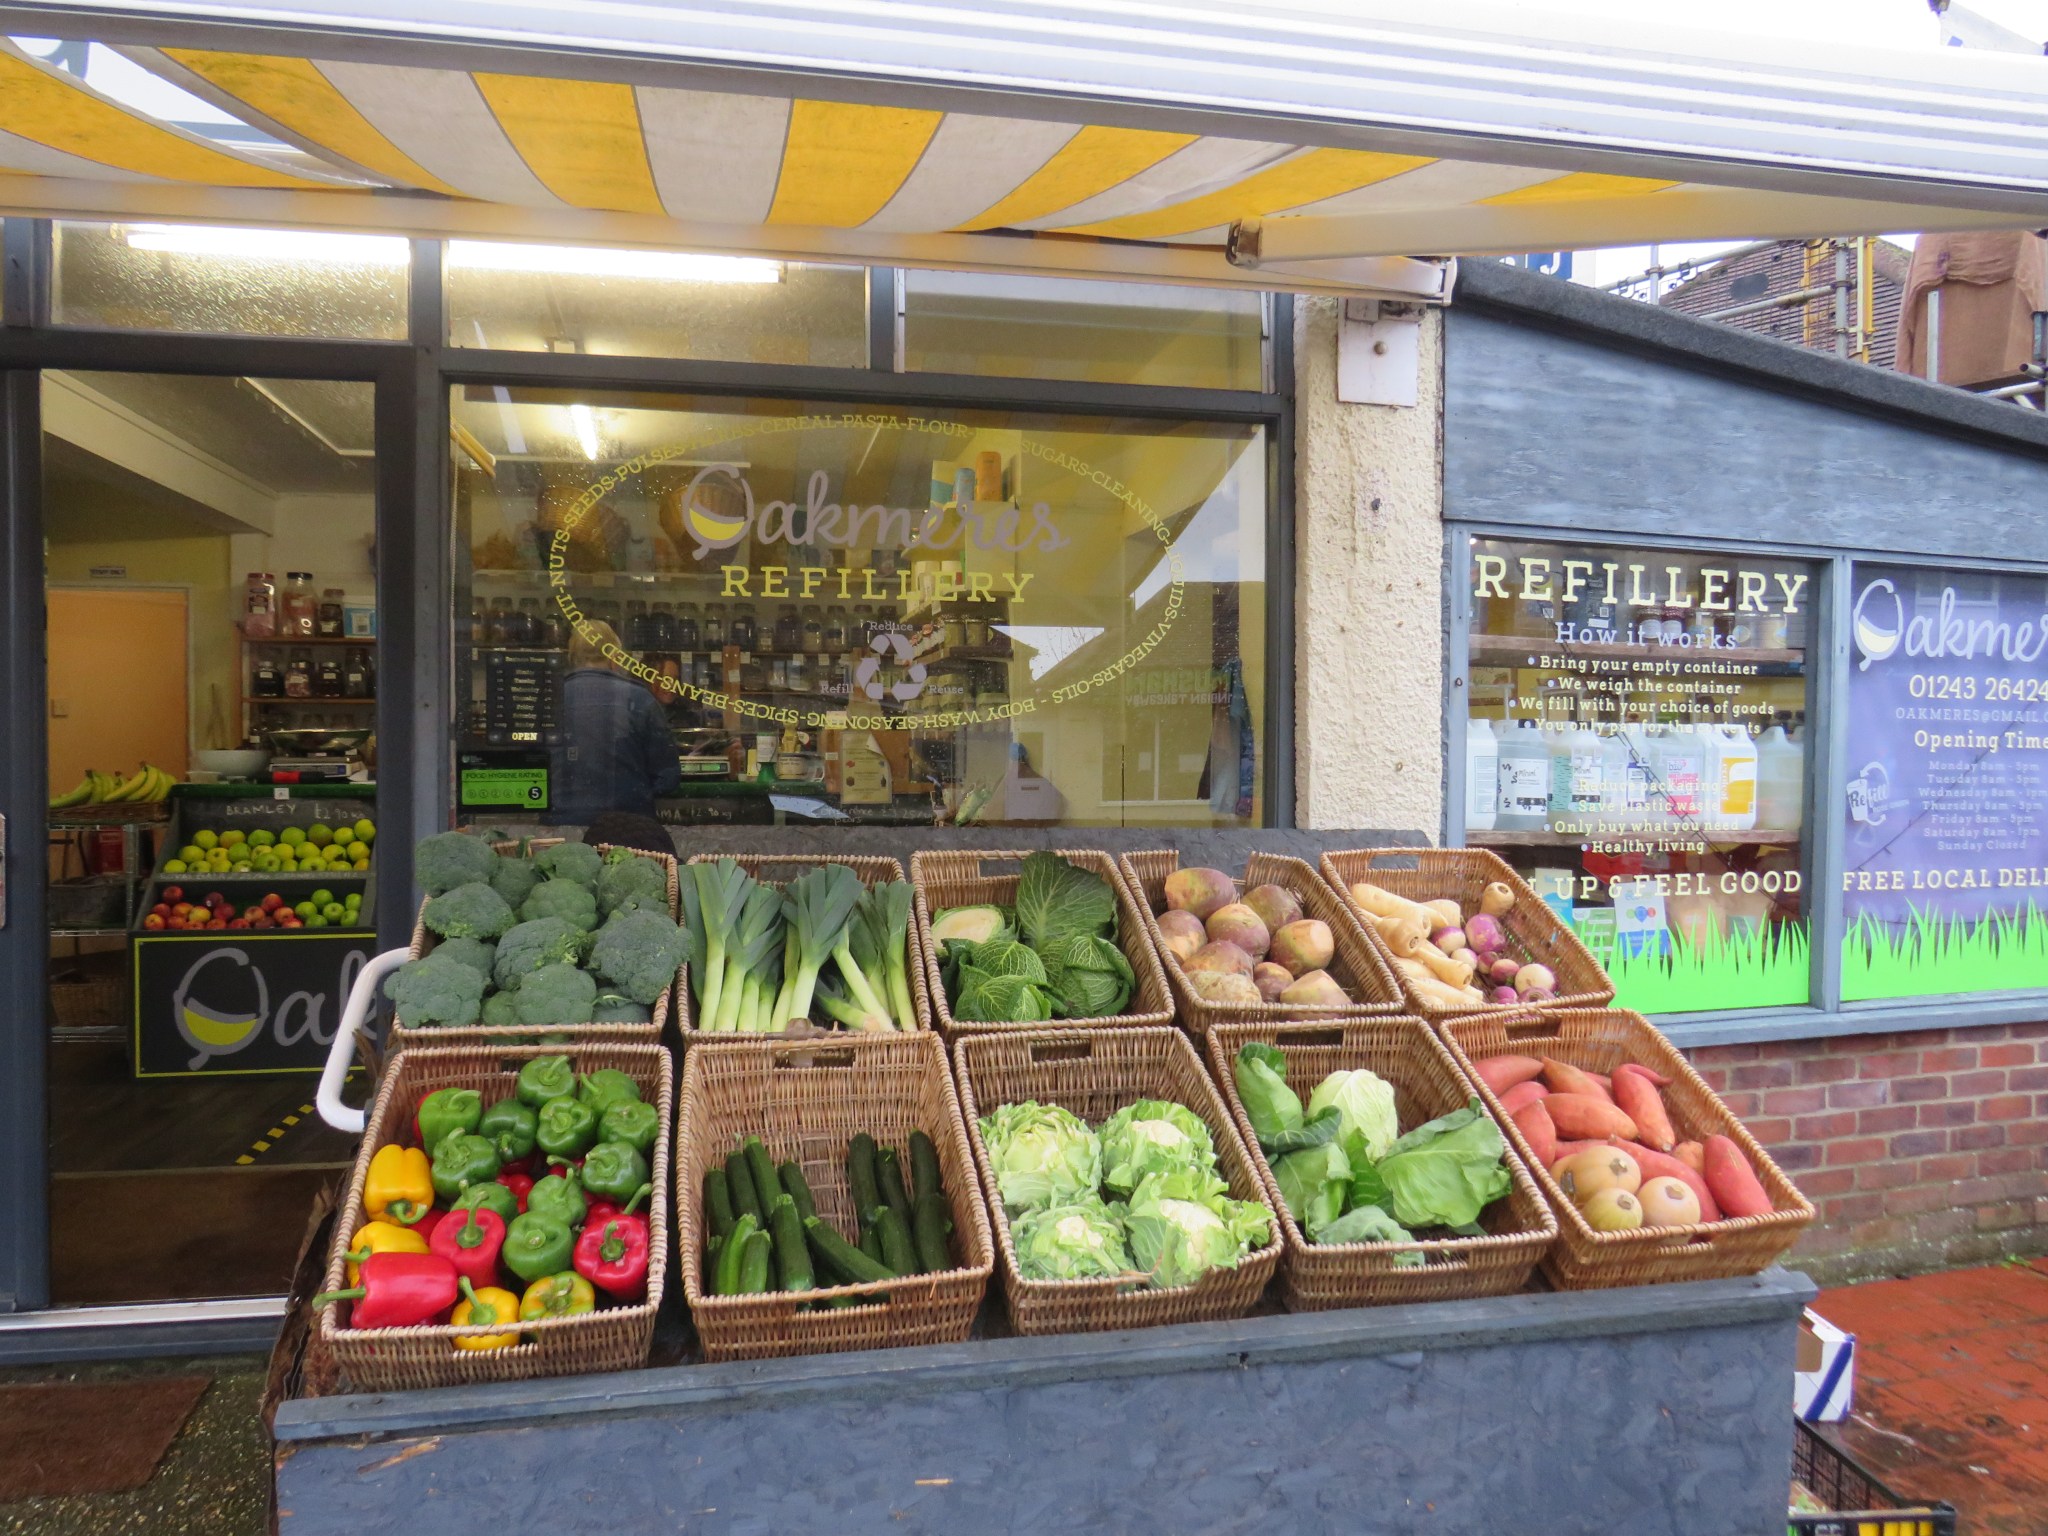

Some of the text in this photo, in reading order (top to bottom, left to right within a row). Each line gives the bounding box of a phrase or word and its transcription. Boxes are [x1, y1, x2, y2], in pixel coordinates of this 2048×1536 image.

[682, 463, 1071, 561] Oakmeres
[720, 565, 1035, 603] REFILLERY
[1473, 554, 1808, 614] REFILLERY
[869, 621, 914, 632] Reduce
[1555, 622, 1738, 650] How it works
[1540, 656, 1758, 676] Bring your empty container
[820, 683, 854, 695] Refill
[928, 684, 964, 695] Reuse
[1558, 677, 1741, 695] We weigh the container
[1909, 674, 2048, 702] 01243 26424
[1519, 697, 1775, 717] We fill with your choice of goods
[1534, 719, 1565, 732] You
[1570, 719, 1607, 736] only
[1642, 719, 1665, 733] for
[511, 732, 538, 741] OPEN
[1914, 730, 2048, 753] Opening Time
[1929, 761, 1976, 772] Monday
[1579, 779, 1636, 792] Reduce
[1640, 779, 1721, 796] packaging
[1927, 774, 1978, 785] Tuesday
[531, 788, 540, 799] 5
[1918, 788, 1987, 798] Wednesday
[225, 802, 297, 816] BRAMLEY
[1579, 800, 1615, 812] Save
[1619, 800, 1674, 815] plastic
[1922, 801, 1981, 811] Thursday
[1554, 819, 1740, 836] Only buy what you need
[1931, 815, 1972, 825] Friday
[1923, 828, 1979, 838] Saturday
[1591, 839, 1705, 855] Healthy living
[1937, 840, 2027, 851] Sunday Closed
[1555, 876, 1598, 900] UP
[1608, 875, 1623, 897] &
[1633, 873, 1711, 897] FEEL
[1720, 870, 1802, 894] GOOD
[1842, 871, 1905, 892] FREE
[1912, 869, 1992, 889] LOCAL
